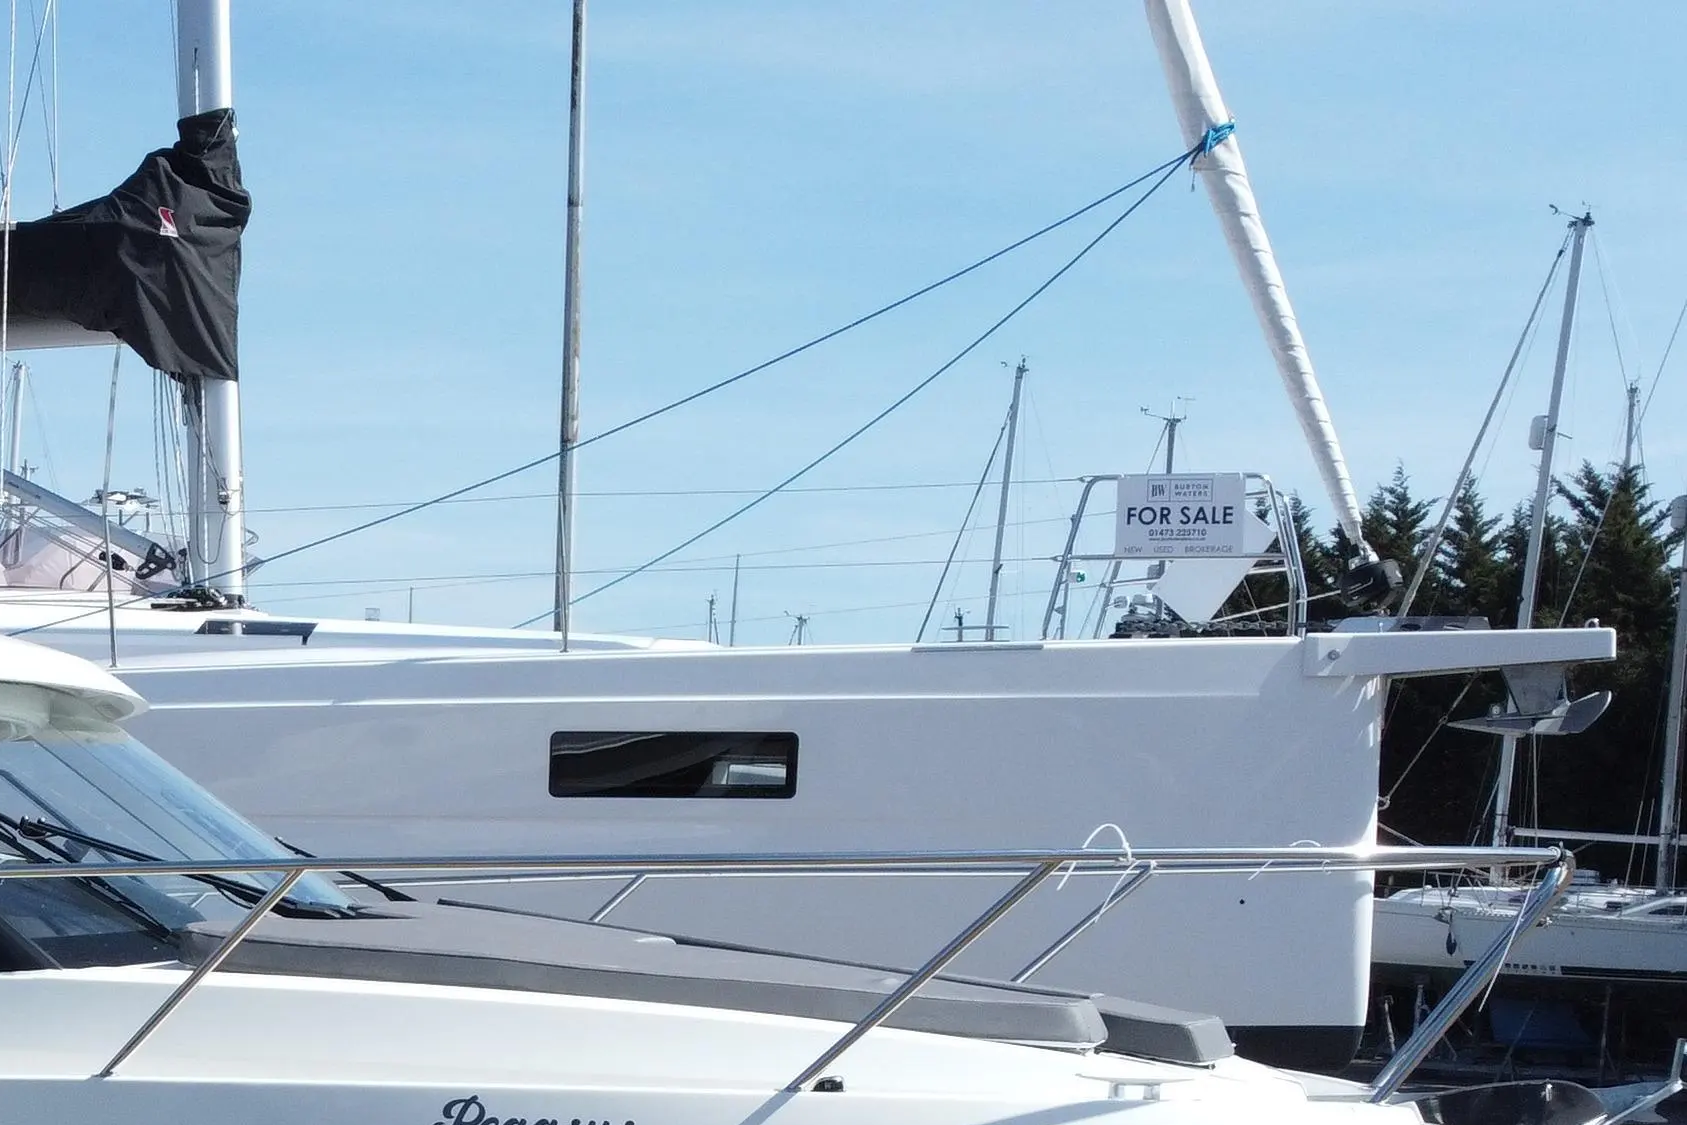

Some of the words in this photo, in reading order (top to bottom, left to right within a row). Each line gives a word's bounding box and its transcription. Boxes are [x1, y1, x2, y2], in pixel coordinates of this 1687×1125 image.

[1127, 506, 1171, 525] FOR
[1180, 506, 1234, 525] SALE
[1148, 528, 1174, 537] 01473
